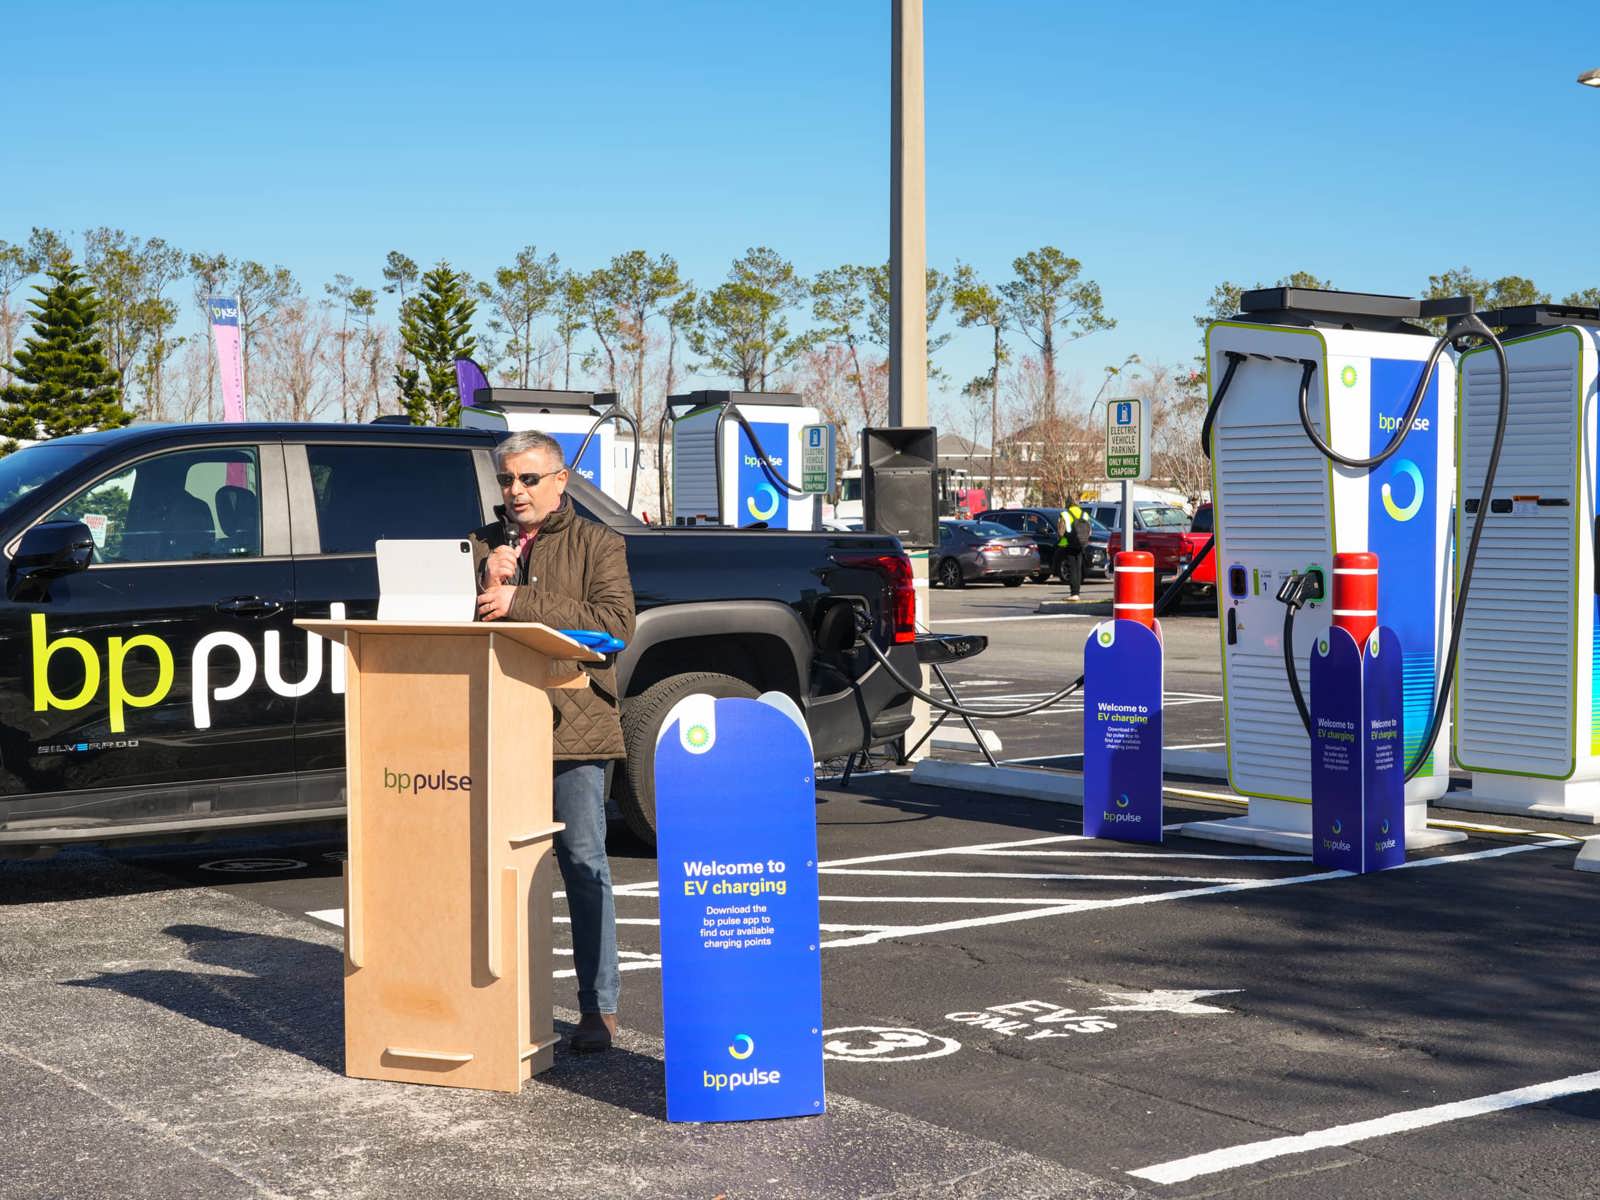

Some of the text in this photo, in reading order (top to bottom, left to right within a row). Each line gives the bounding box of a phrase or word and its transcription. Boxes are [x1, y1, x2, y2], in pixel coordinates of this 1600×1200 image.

[1379, 412, 1395, 433] bp
[1110, 426, 1136, 435] ELECTRIC
[1111, 435, 1136, 445] VEHICLE
[1111, 445, 1136, 454] PARKING
[744, 455, 757, 468] bp
[1109, 457, 1138, 465] ONLY WHILE
[1110, 467, 1137, 476] CHARGING
[30, 602, 346, 733] bp pul
[1097, 702, 1148, 713] Welcome to
[1097, 712, 1148, 724] EV charging
[1318, 718, 1354, 729] Welcome to
[1371, 719, 1391, 729] Welcome
[1318, 730, 1354, 742] EV charging
[384, 768, 472, 795] bp pulse
[1103, 811, 1141, 823] bp pulse
[683, 860, 785, 876] Welcome to
[684, 878, 787, 896] EV charging
[706, 904, 767, 915] Download the
[703, 917, 715, 927] bp
[717, 916, 741, 926] pulse
[742, 917, 759, 925] app
[700, 928, 717, 937] find
[737, 926, 774, 936] available
[704, 937, 772, 949] charging points
[945, 1012, 1071, 1040] ONLY
[703, 1068, 781, 1091] bp pulse
